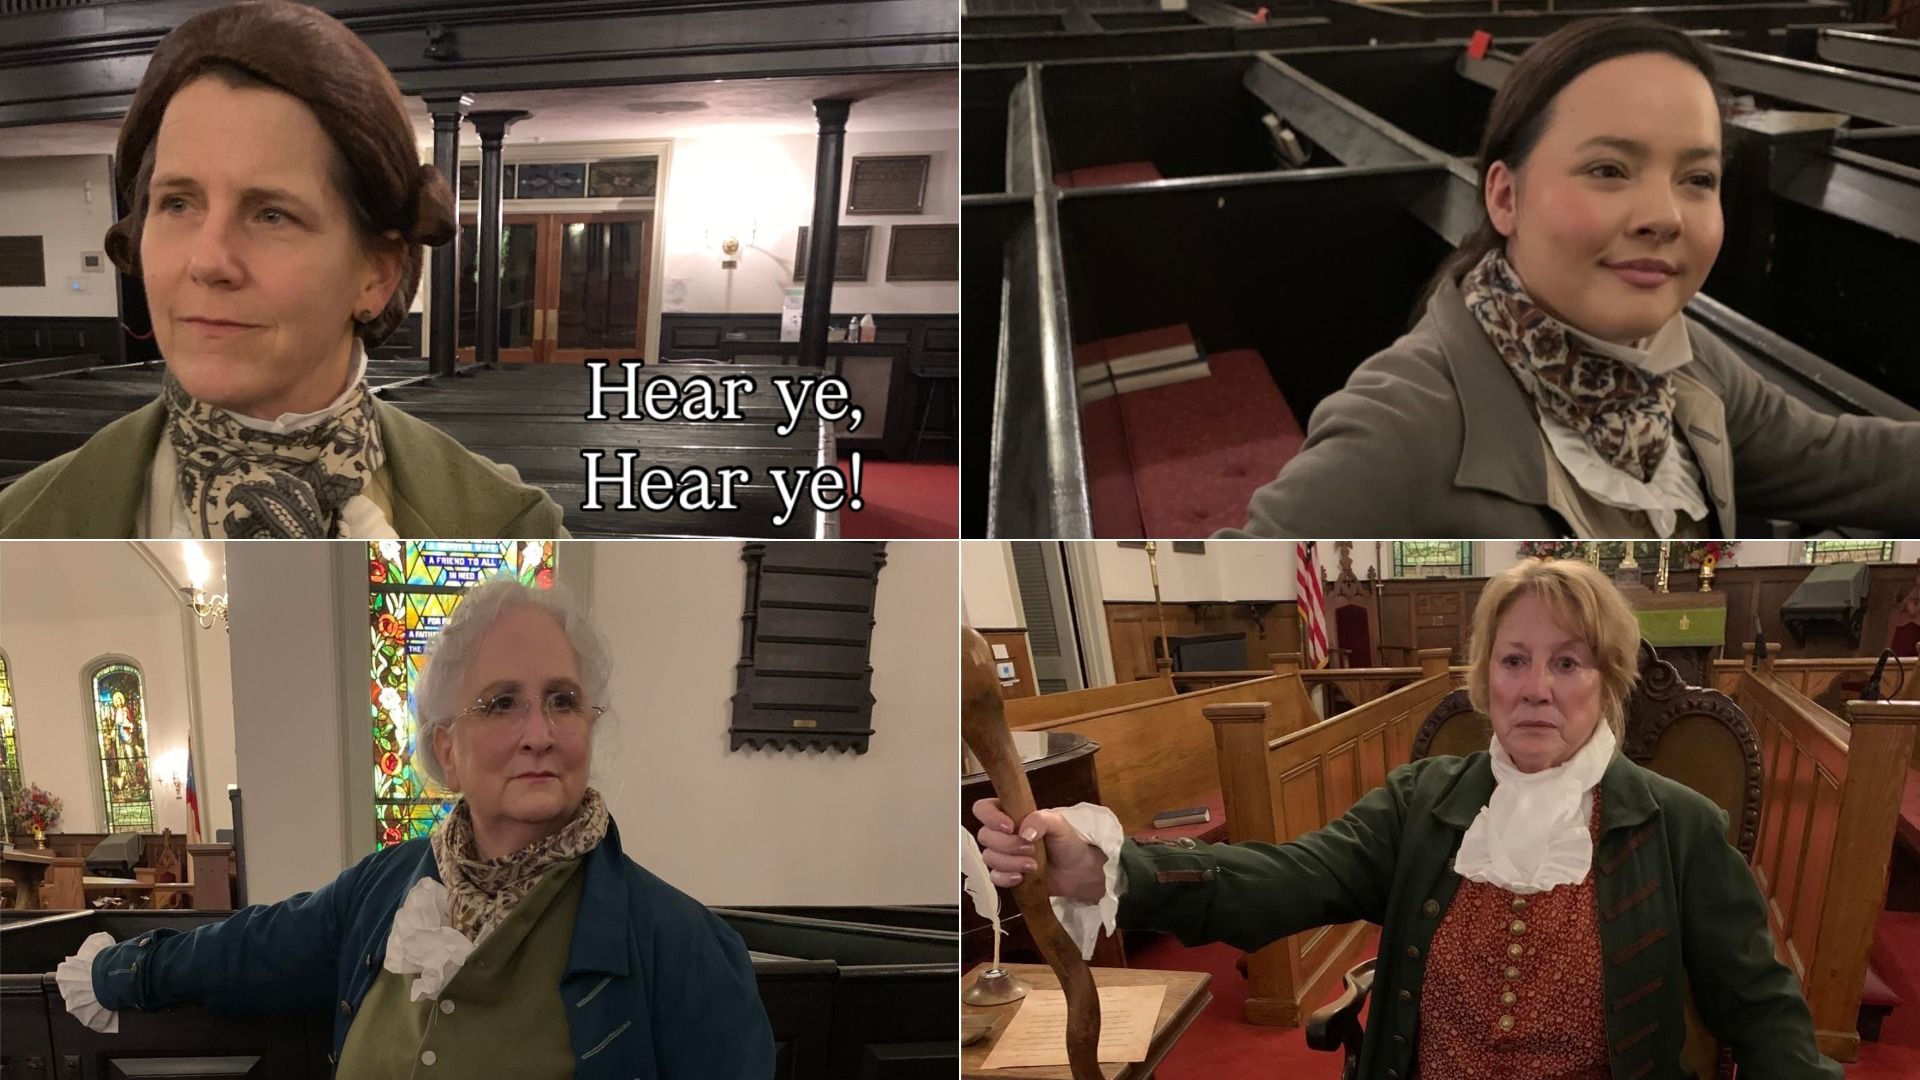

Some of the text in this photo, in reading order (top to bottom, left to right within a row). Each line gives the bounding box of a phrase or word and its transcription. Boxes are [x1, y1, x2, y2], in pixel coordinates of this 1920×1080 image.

[428, 556, 497, 567] A FRIEND TO ALL
[457, 572, 476, 580] NEED
[408, 645, 422, 653] THE
